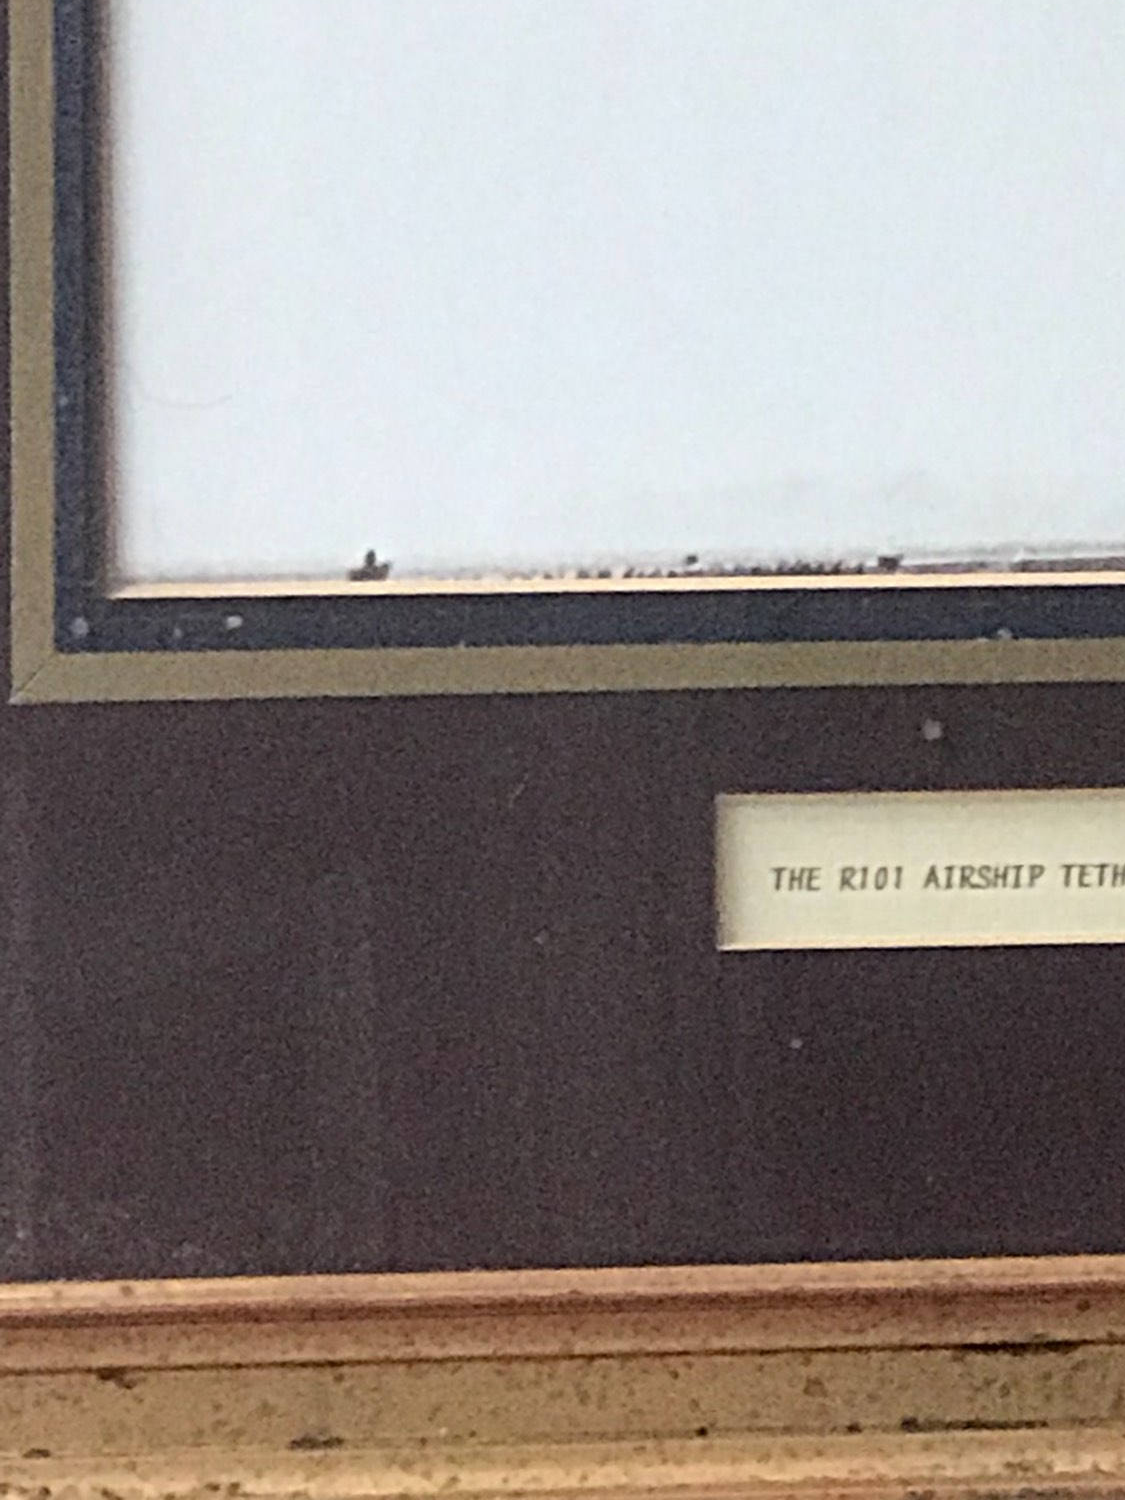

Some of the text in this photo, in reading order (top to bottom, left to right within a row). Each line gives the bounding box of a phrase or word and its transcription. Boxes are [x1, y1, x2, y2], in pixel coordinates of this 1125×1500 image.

[771, 866, 822, 892] THE
[838, 865, 904, 891] R101
[922, 863, 1046, 890] AIRSHIP
